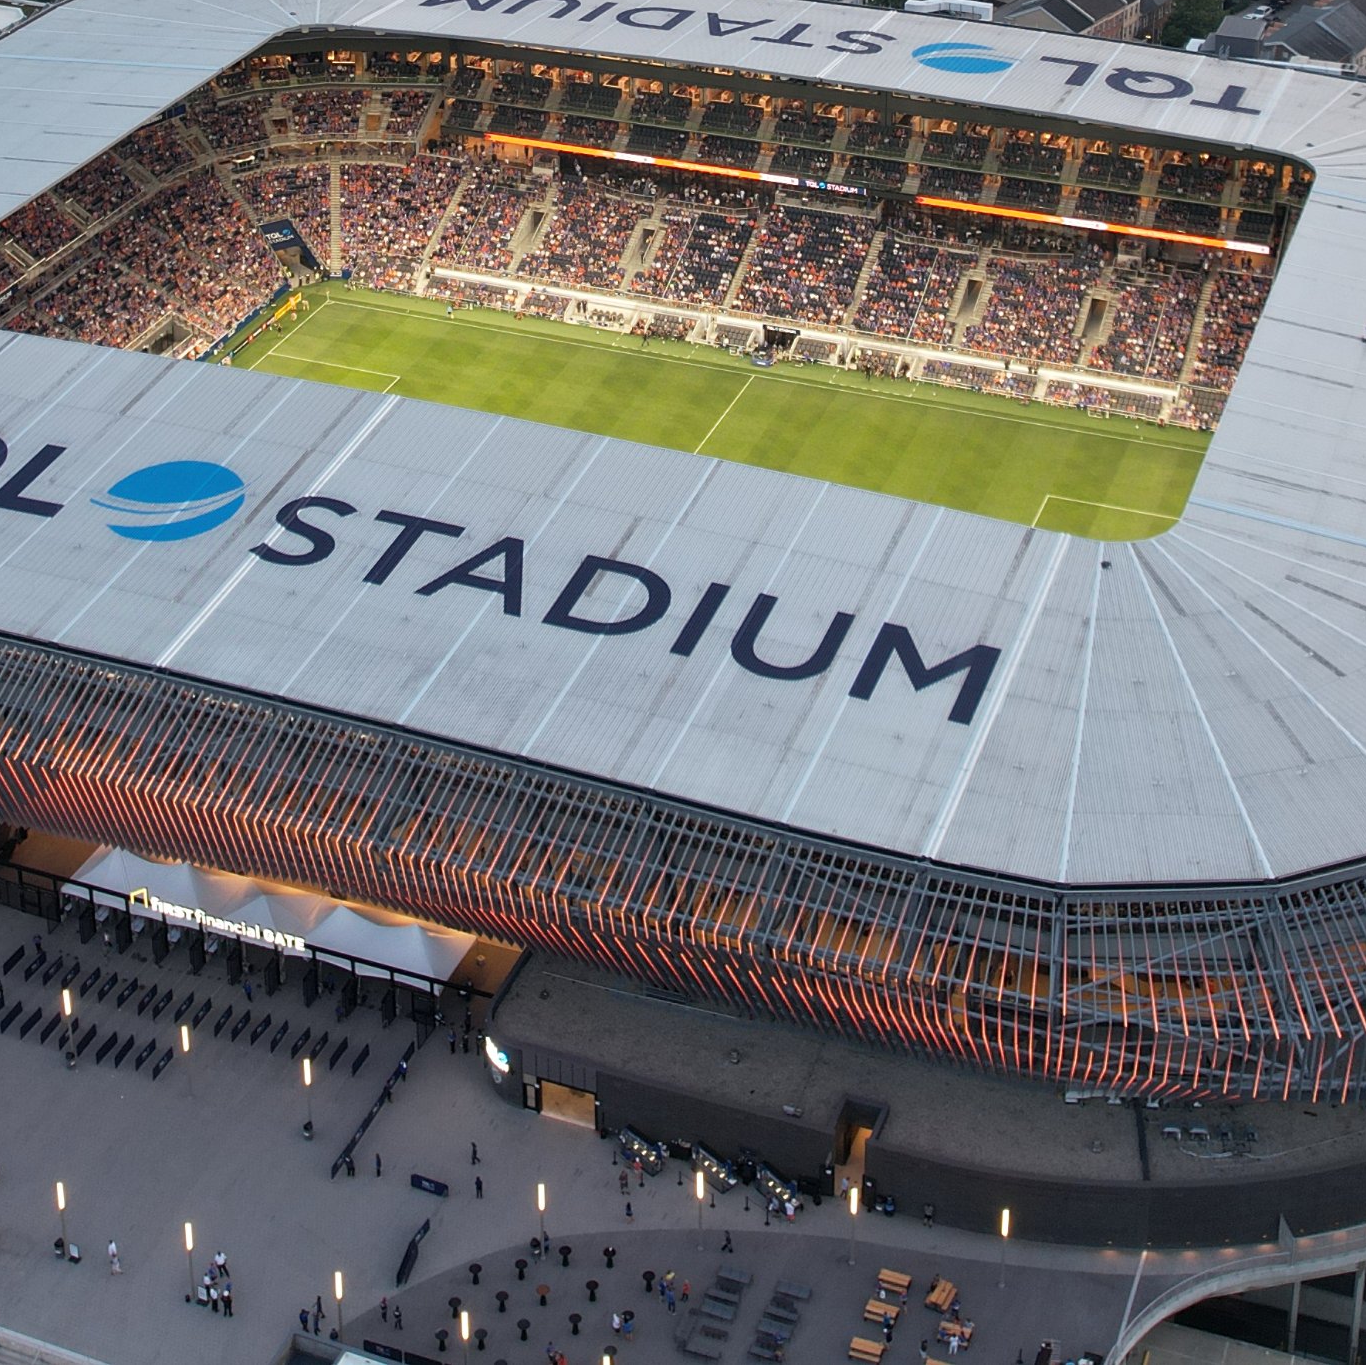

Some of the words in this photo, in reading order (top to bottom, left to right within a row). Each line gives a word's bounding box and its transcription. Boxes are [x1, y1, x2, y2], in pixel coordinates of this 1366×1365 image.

[1039, 55, 1262, 116] TQL
[804, 179, 819, 189] TQL
[826, 183, 858, 194] STADIUM
[265, 231, 284, 240] TQL
[248, 495, 1003, 726] STADIUM
[193, 908, 261, 940] financial
[262, 928, 306, 952] GATE
